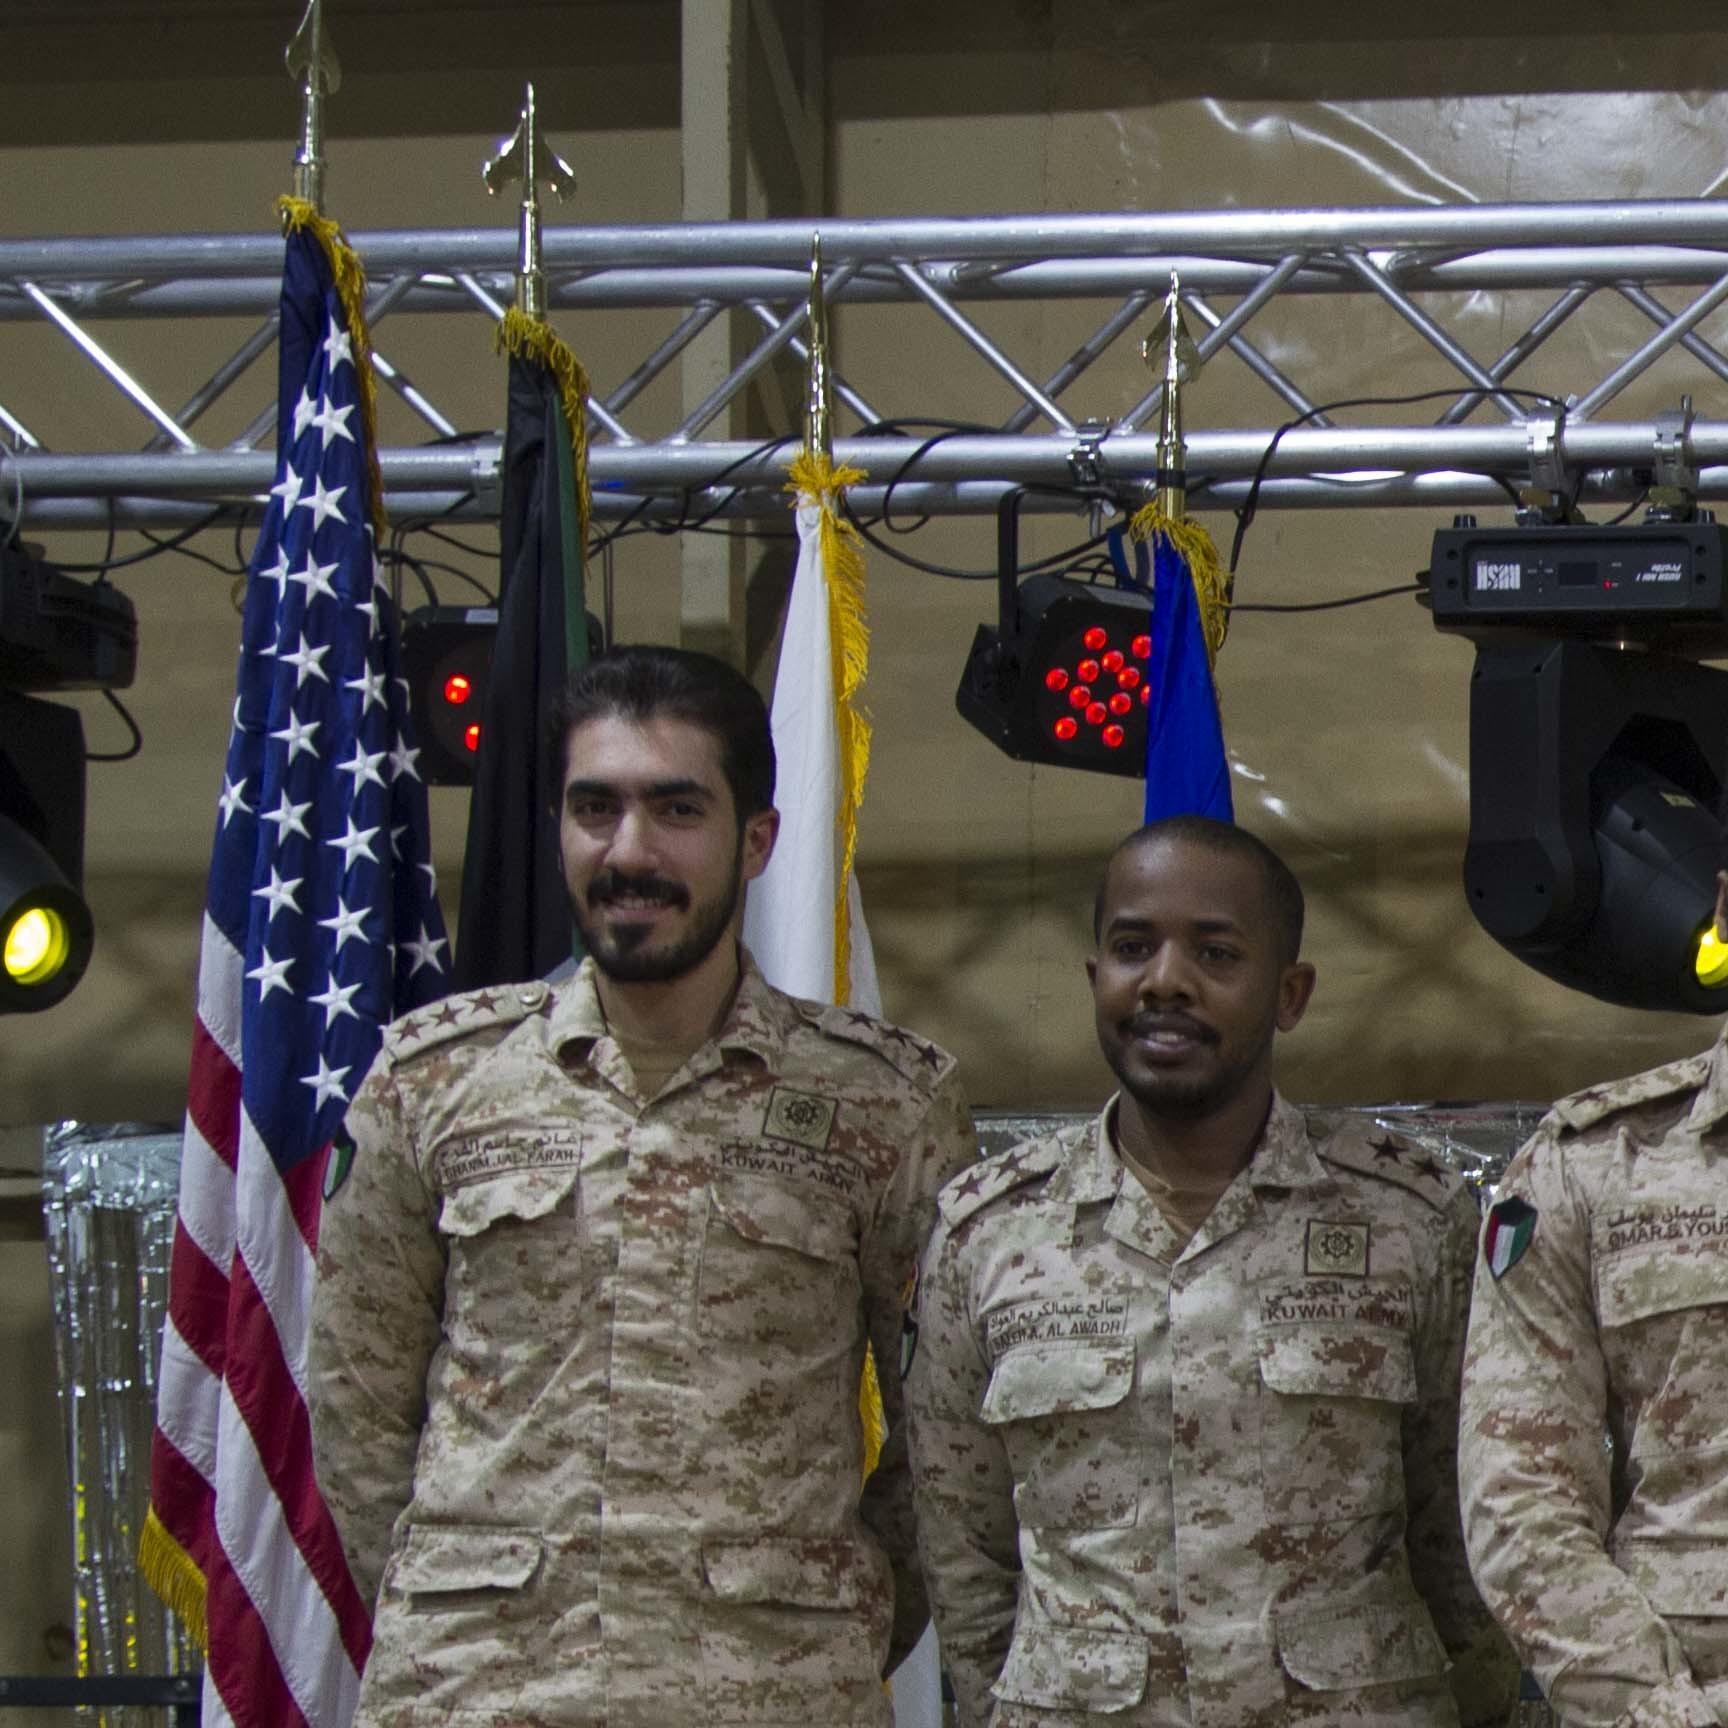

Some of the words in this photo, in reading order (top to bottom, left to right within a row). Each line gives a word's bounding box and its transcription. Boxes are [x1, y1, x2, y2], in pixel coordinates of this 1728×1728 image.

[721, 1151, 798, 1177] KUWAIT
[1267, 1303, 1349, 1322] KUWAIT
[1069, 1319, 1121, 1335] AWADH
